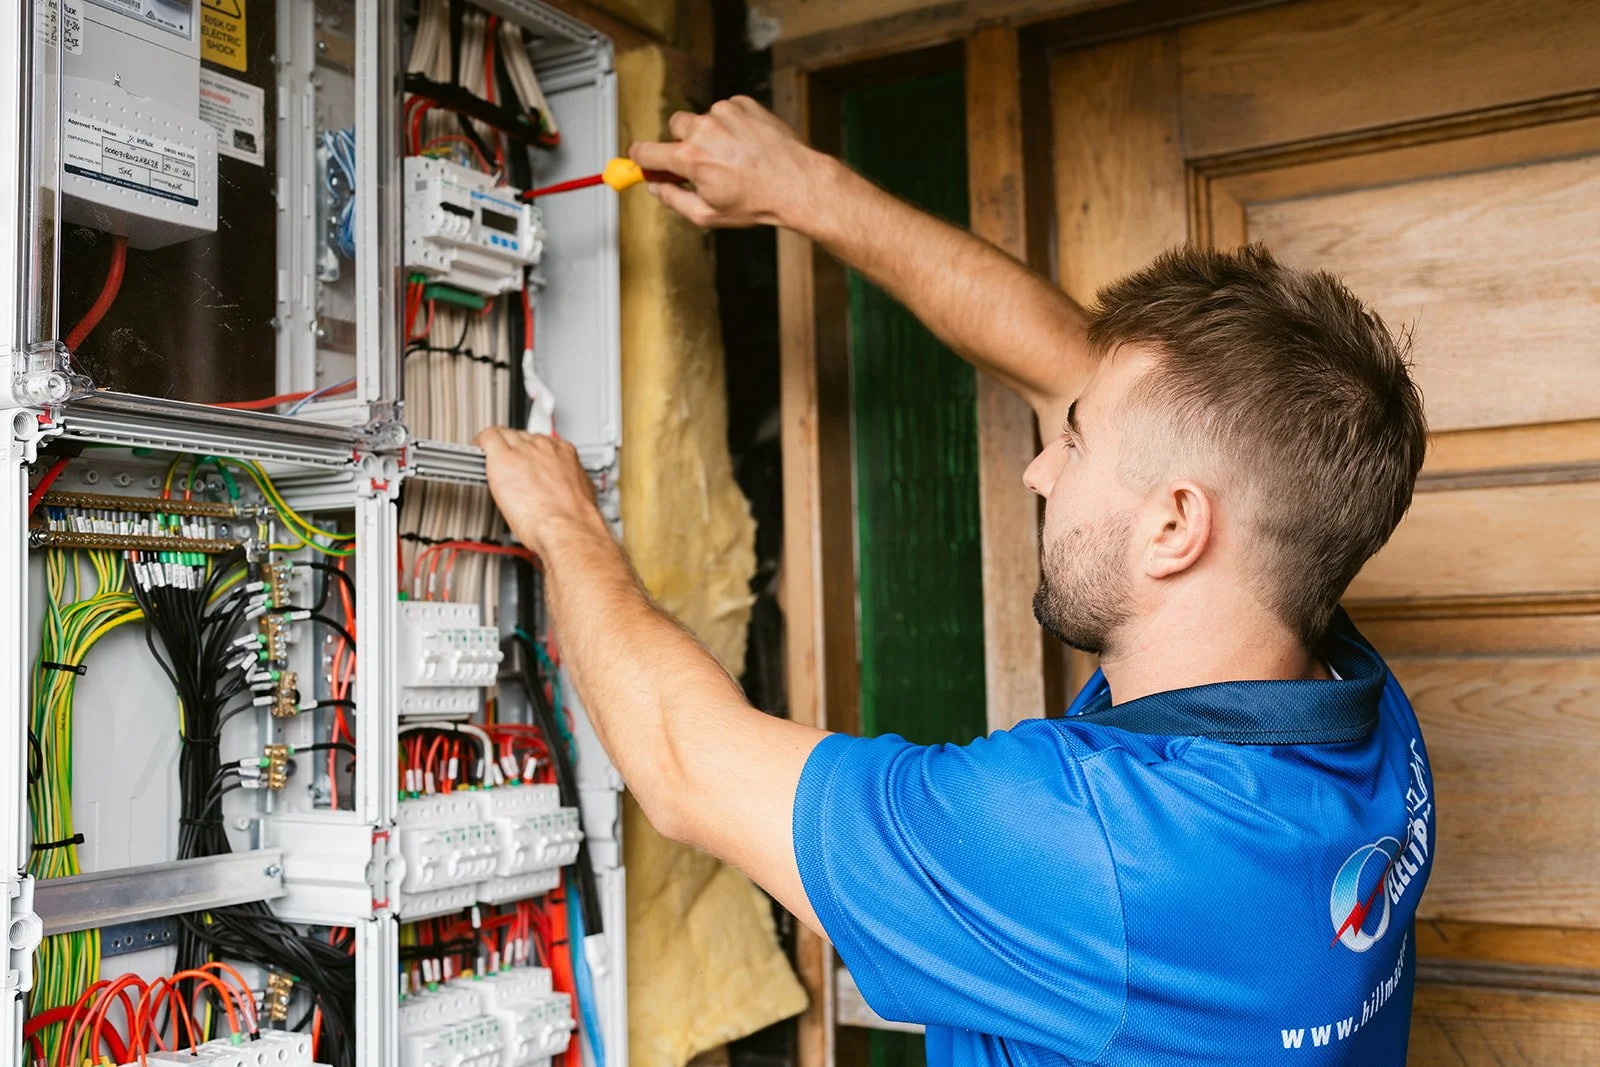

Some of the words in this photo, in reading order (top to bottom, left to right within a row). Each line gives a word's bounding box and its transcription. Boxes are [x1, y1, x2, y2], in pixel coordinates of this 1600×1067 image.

[204, 14, 224, 27] RISK
[226, 22, 237, 32] OF
[201, 25, 242, 47] ELECTRIC
[206, 39, 237, 57] SHOCK
[136, 136, 154, 148] influx
